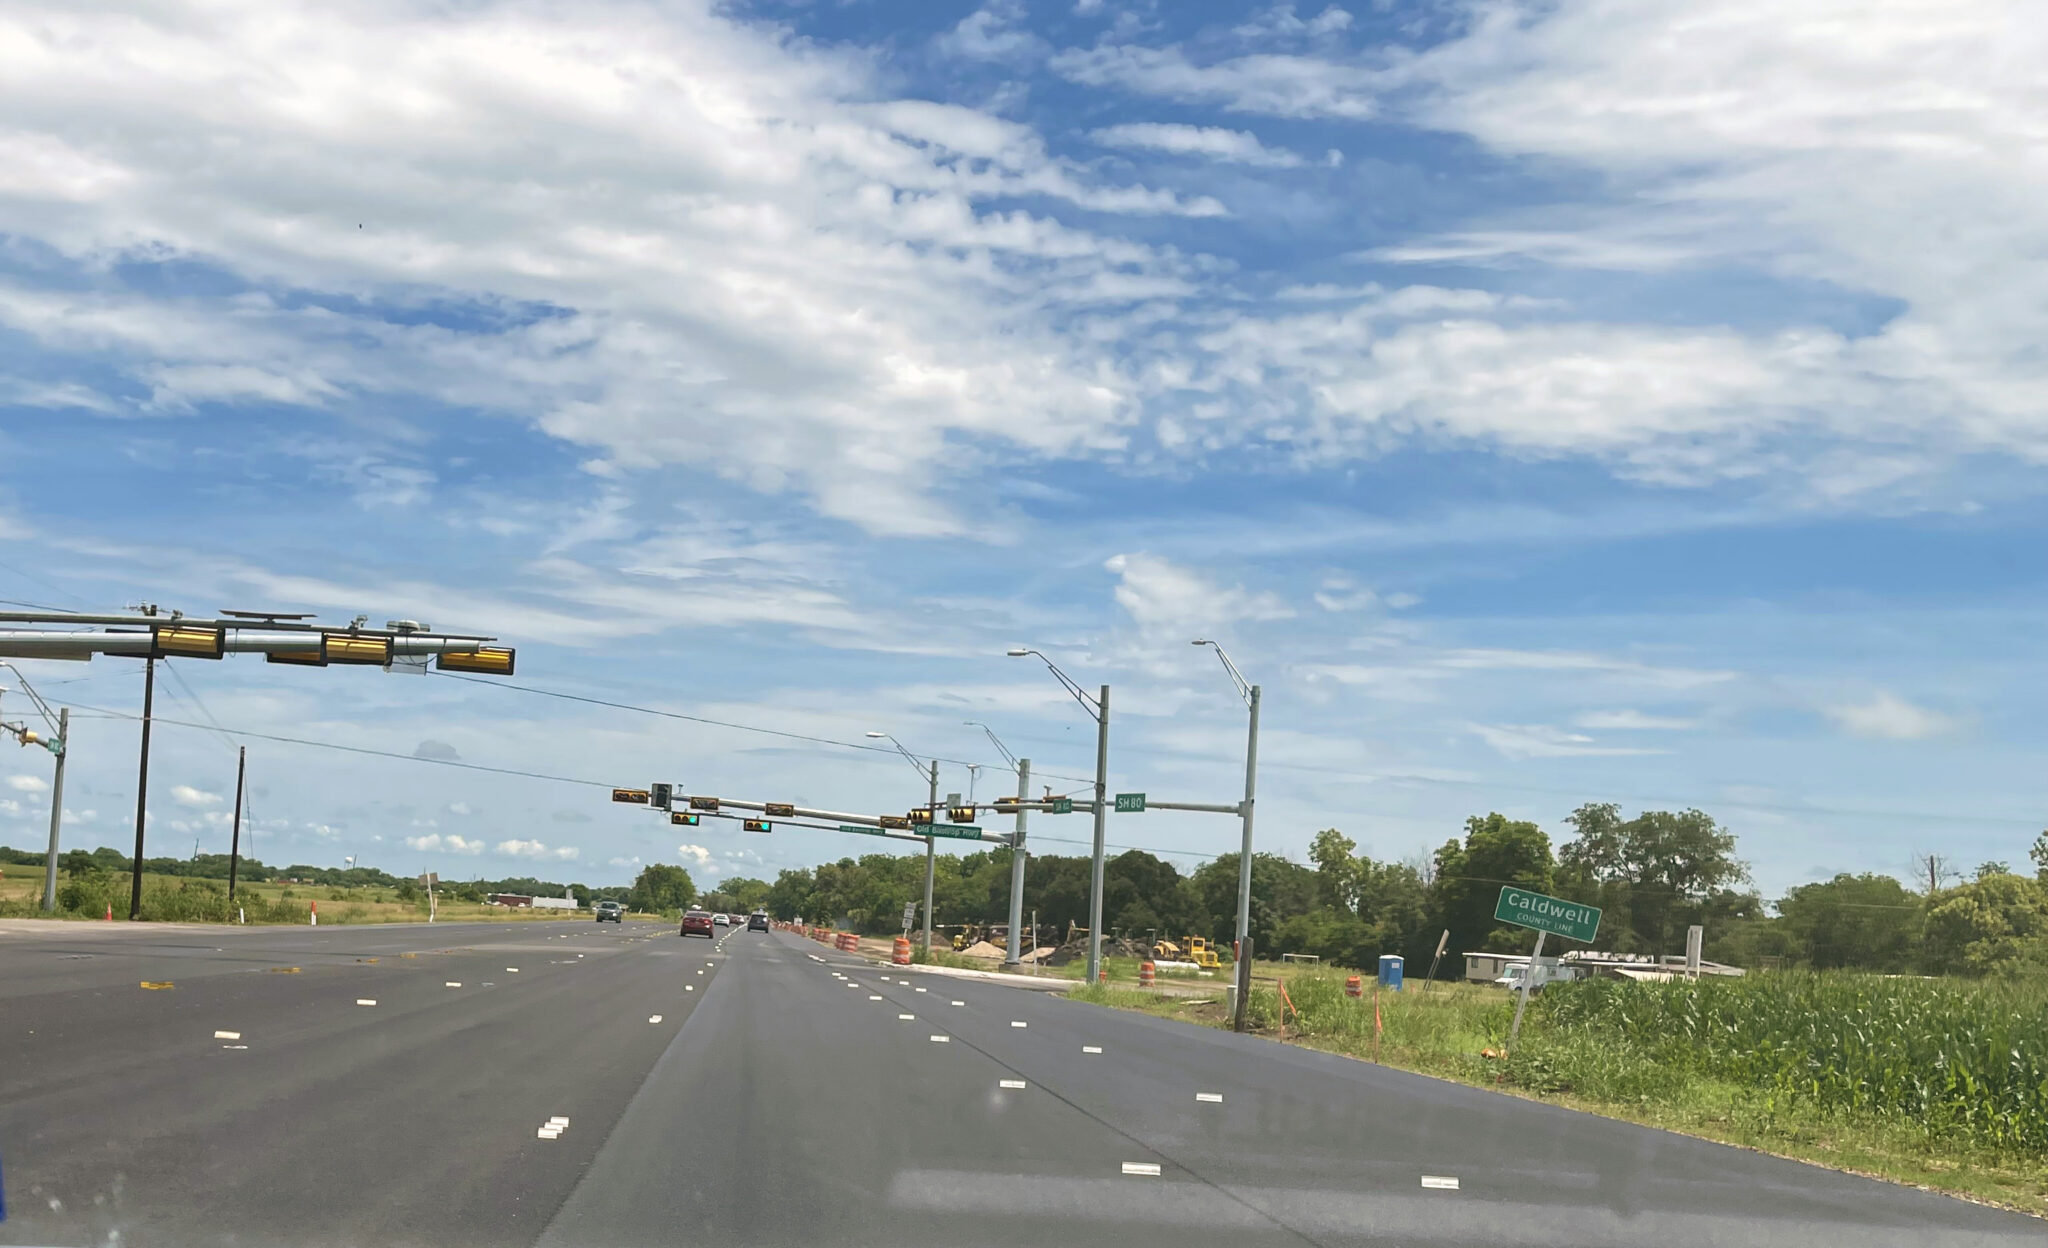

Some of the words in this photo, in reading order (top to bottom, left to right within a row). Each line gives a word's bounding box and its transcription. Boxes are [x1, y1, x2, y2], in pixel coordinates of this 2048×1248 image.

[1118, 798, 1129, 809] SH
[1130, 797, 1142, 809] 80
[917, 824, 929, 833] Old
[1508, 893, 1590, 925] Caldwell
[1517, 912, 1552, 927] COUNTY
[1554, 921, 1574, 933] LINE
